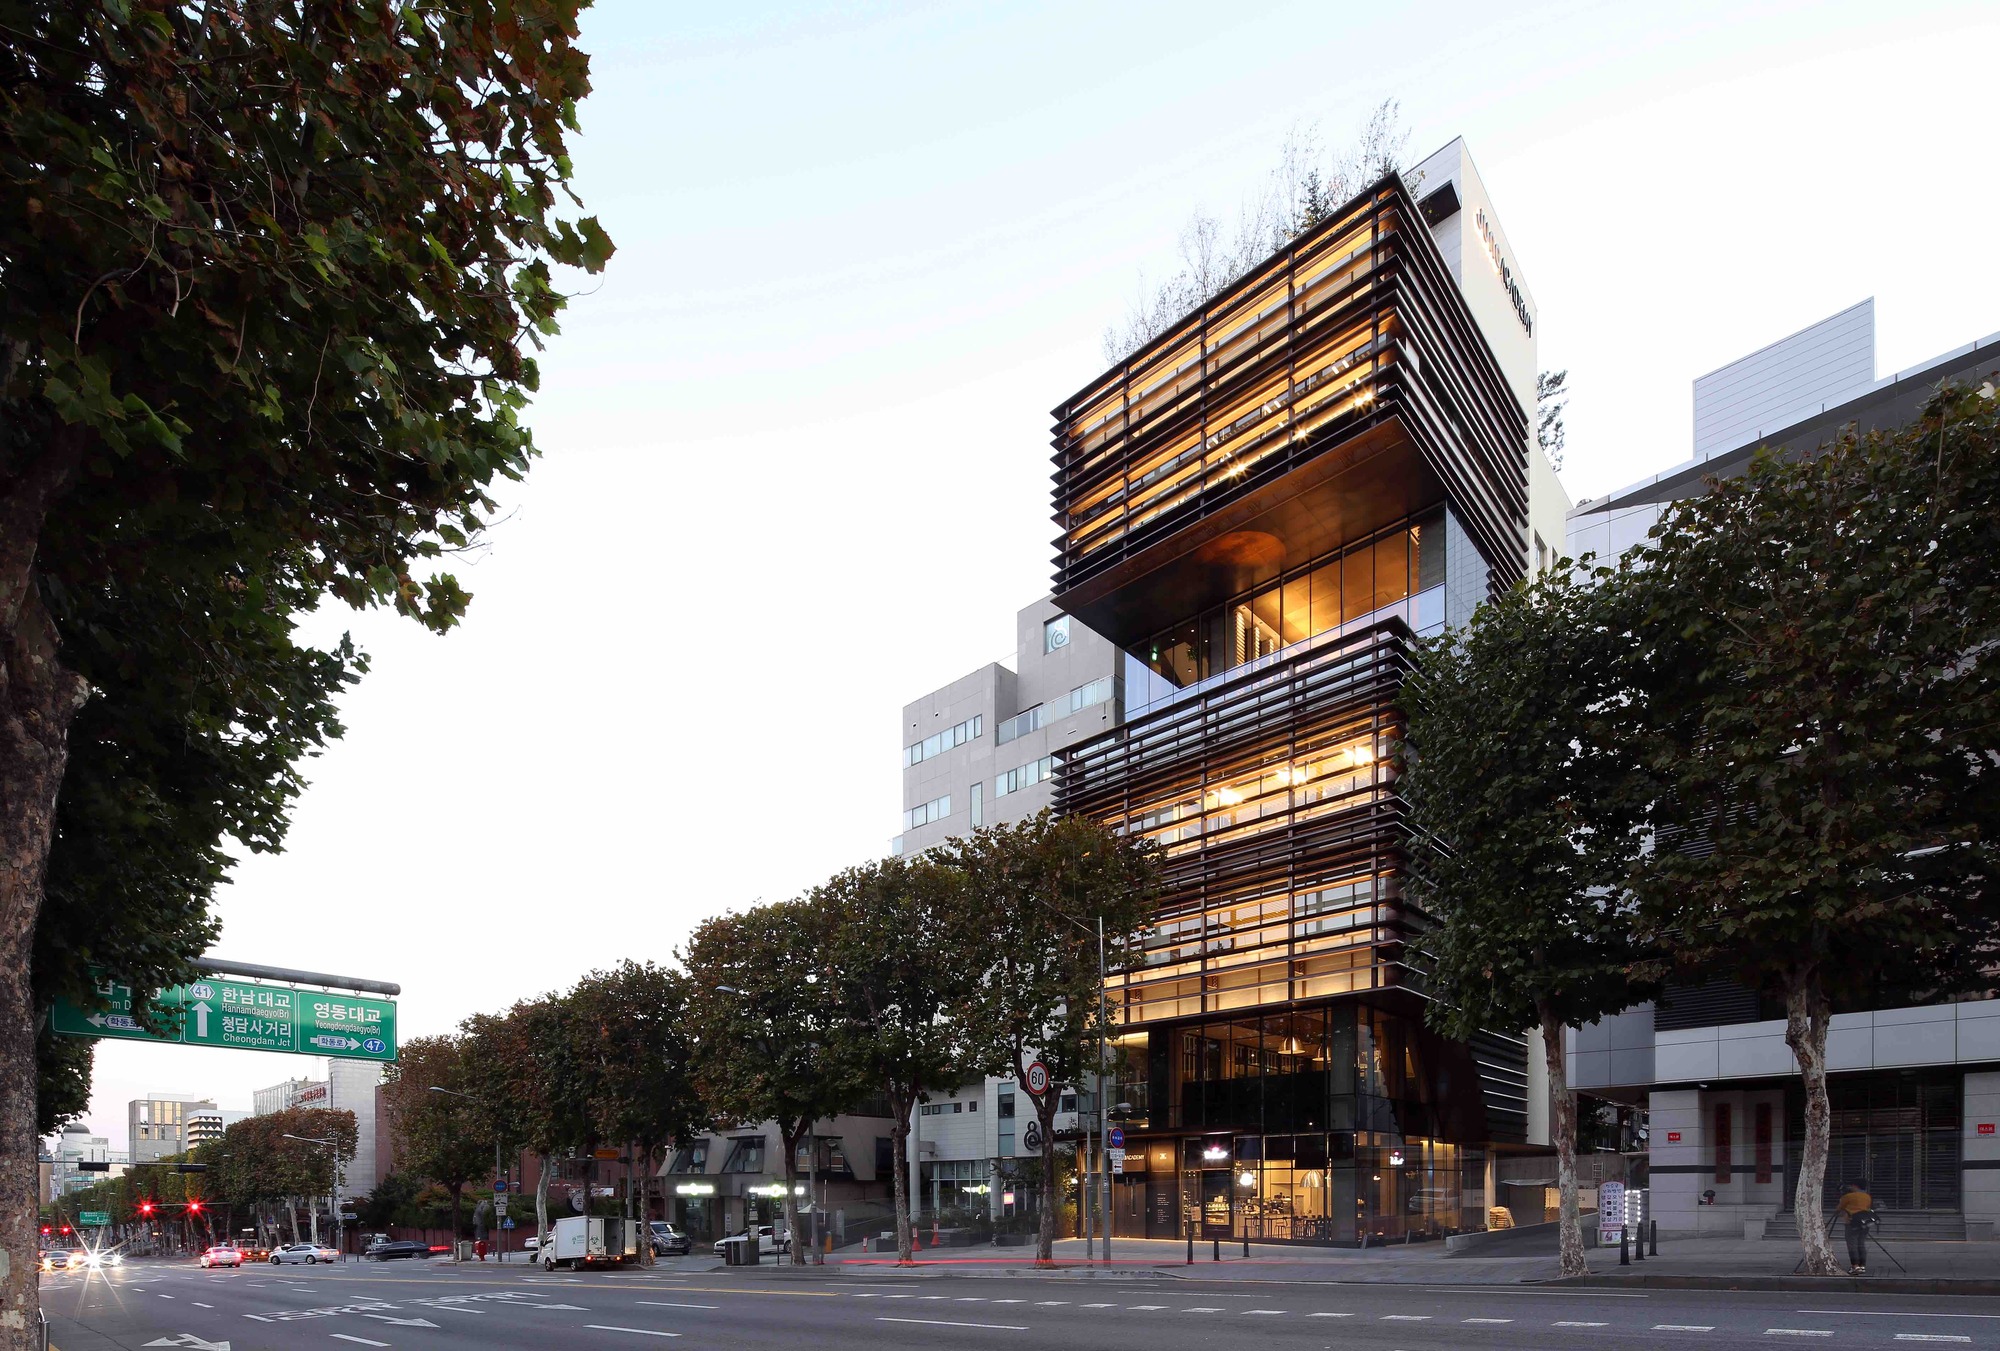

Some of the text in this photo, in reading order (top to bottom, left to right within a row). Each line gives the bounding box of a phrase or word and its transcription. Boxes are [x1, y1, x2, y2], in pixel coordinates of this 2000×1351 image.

[195, 986, 208, 998] 41
[221, 986, 292, 1008] 한남대교
[221, 1003, 290, 1020] Hannamdaegyo(Br)
[313, 1002, 382, 1023] 영동대교
[222, 1016, 292, 1038] 청담사거리
[315, 1019, 381, 1036] Yeongdongdaegyo(Br)
[223, 1033, 291, 1047] Cheongdam Jct
[320, 1036, 344, 1047] 학동로
[366, 1040, 382, 1050] 47
[1031, 1071, 1044, 1086] 60
